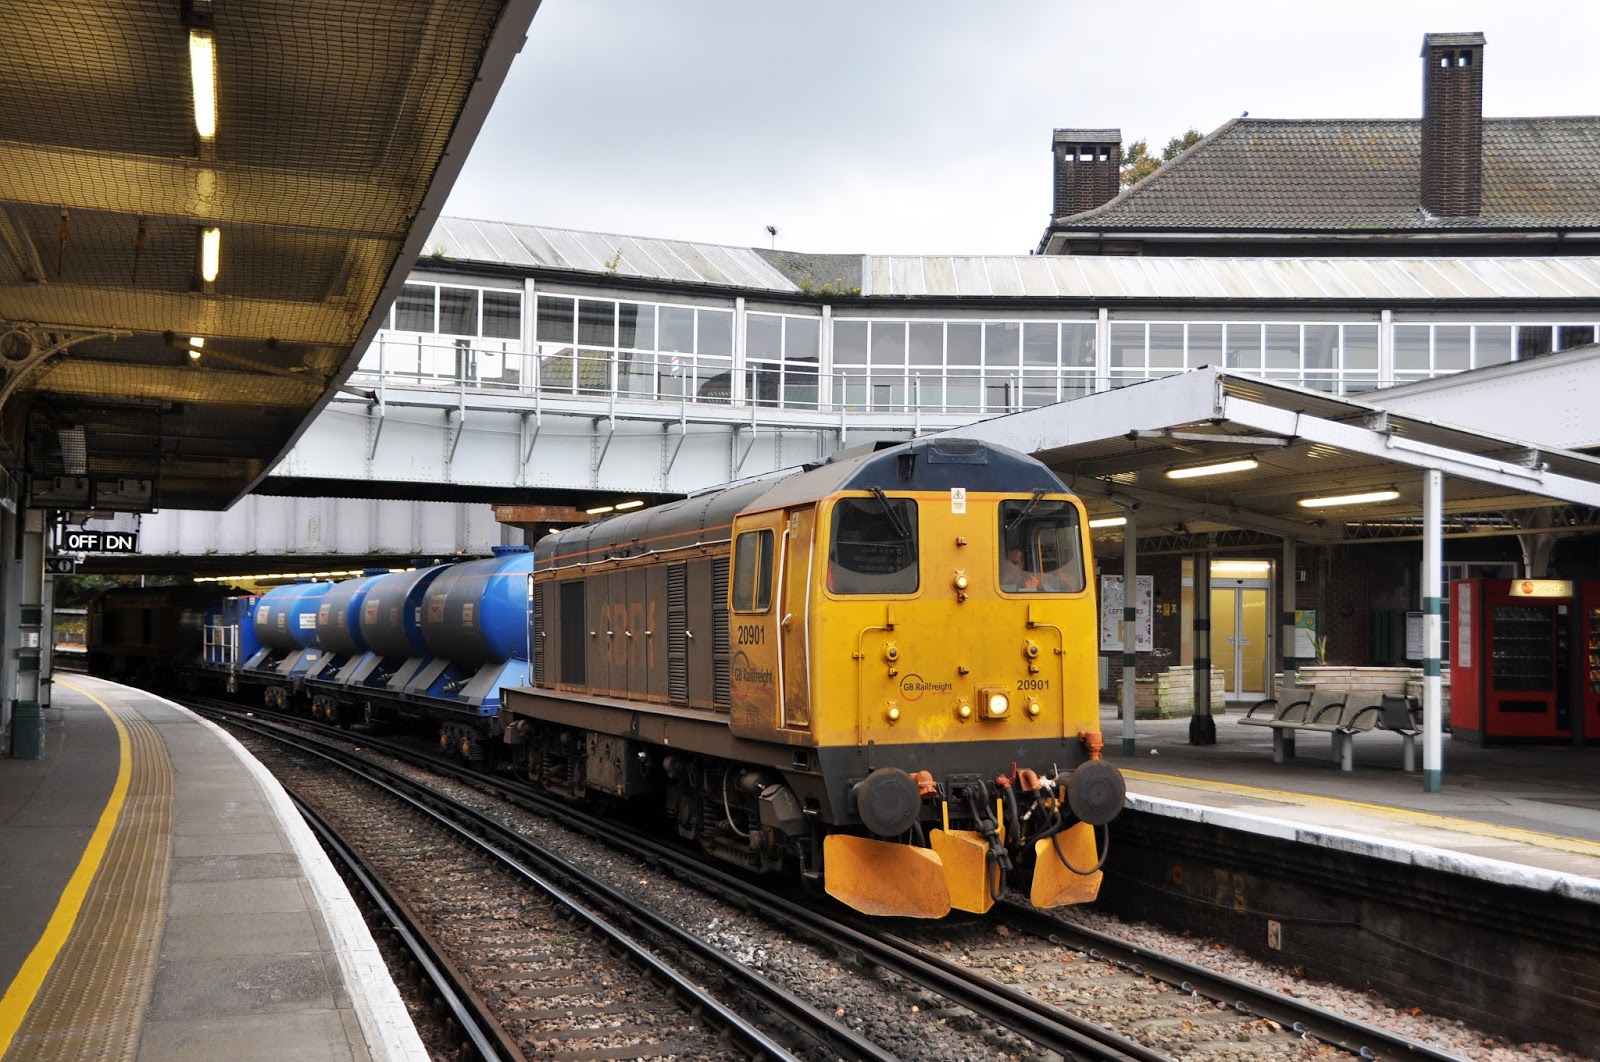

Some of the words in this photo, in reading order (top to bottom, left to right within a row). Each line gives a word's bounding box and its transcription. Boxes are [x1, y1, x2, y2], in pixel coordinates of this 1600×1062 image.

[68, 534, 98, 549] OFF
[106, 535, 132, 550] DN
[738, 625, 765, 645] 20901
[735, 667, 743, 682] GB
[743, 667, 773, 687] Railfreight
[1016, 679, 1050, 691] 20901
[903, 682, 914, 691] GB
[915, 682, 953, 693] Railfreight
